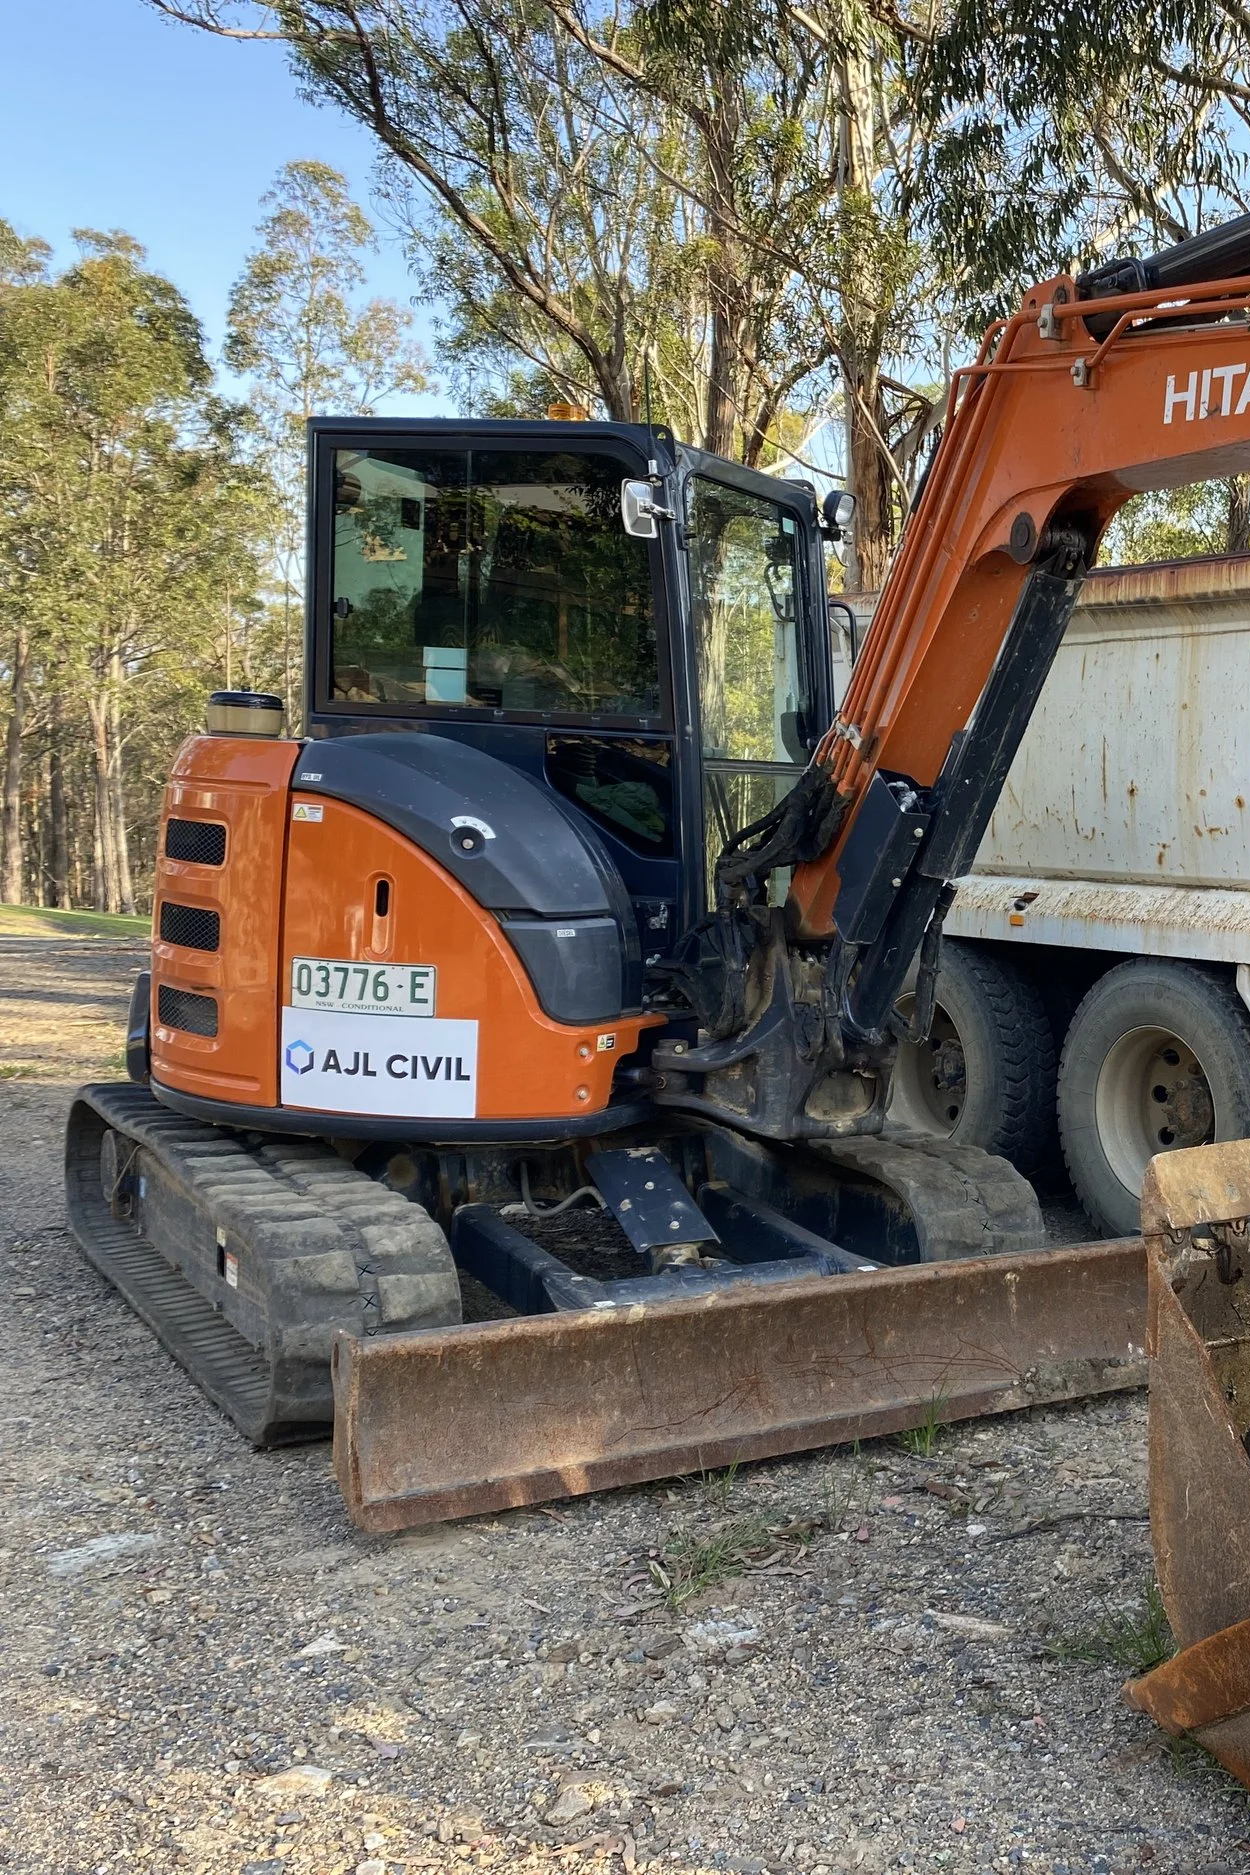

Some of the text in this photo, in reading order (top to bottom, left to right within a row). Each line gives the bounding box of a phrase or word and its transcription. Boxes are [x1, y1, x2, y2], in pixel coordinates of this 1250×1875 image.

[315, 1000, 405, 1013] NSW CONDITIONAL
[321, 1049, 471, 1081] AJL CIVIL
